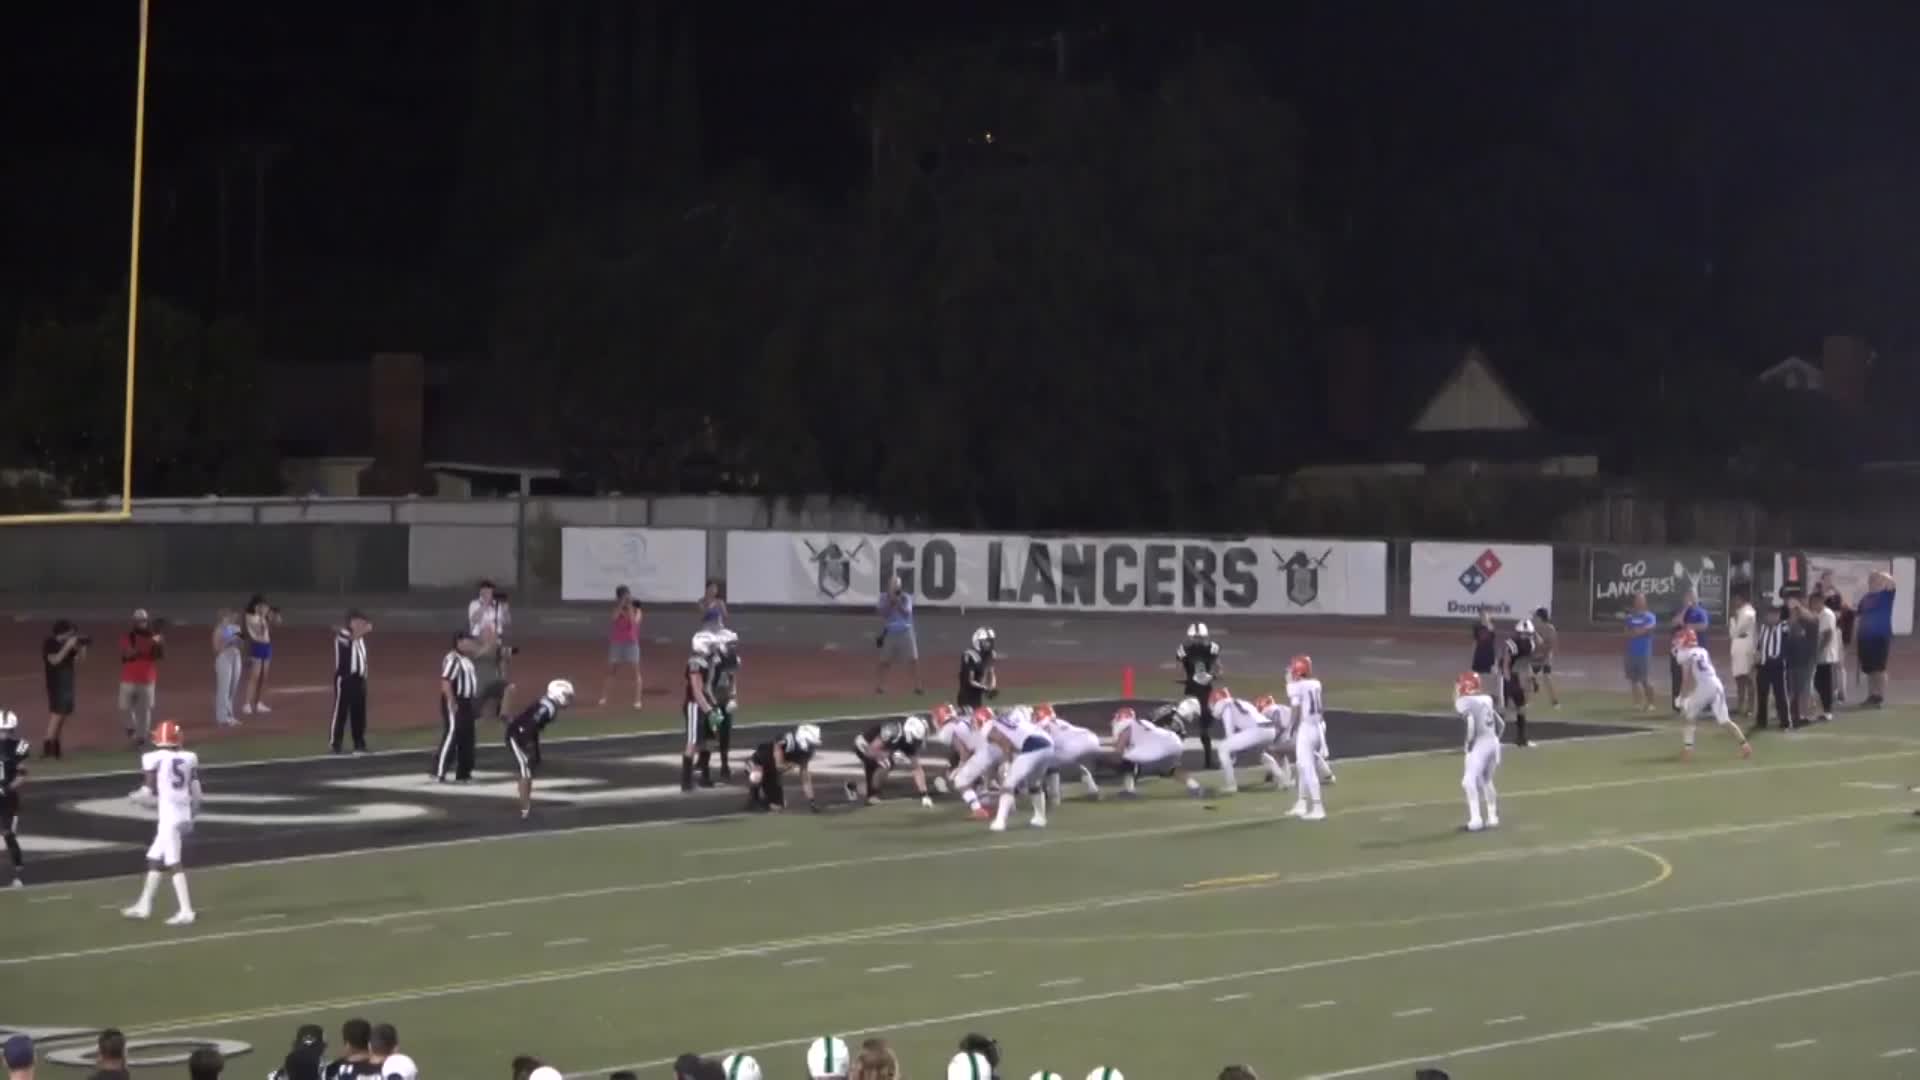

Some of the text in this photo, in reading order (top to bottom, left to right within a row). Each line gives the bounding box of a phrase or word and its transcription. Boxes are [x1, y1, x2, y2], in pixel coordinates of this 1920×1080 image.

[879, 538, 1259, 609] GO LANCERS
[1621, 560, 1647, 578] GO
[1787, 556, 1799, 582] 1
[1596, 576, 1676, 600] LANCERS!
[171, 757, 187, 789] 5
